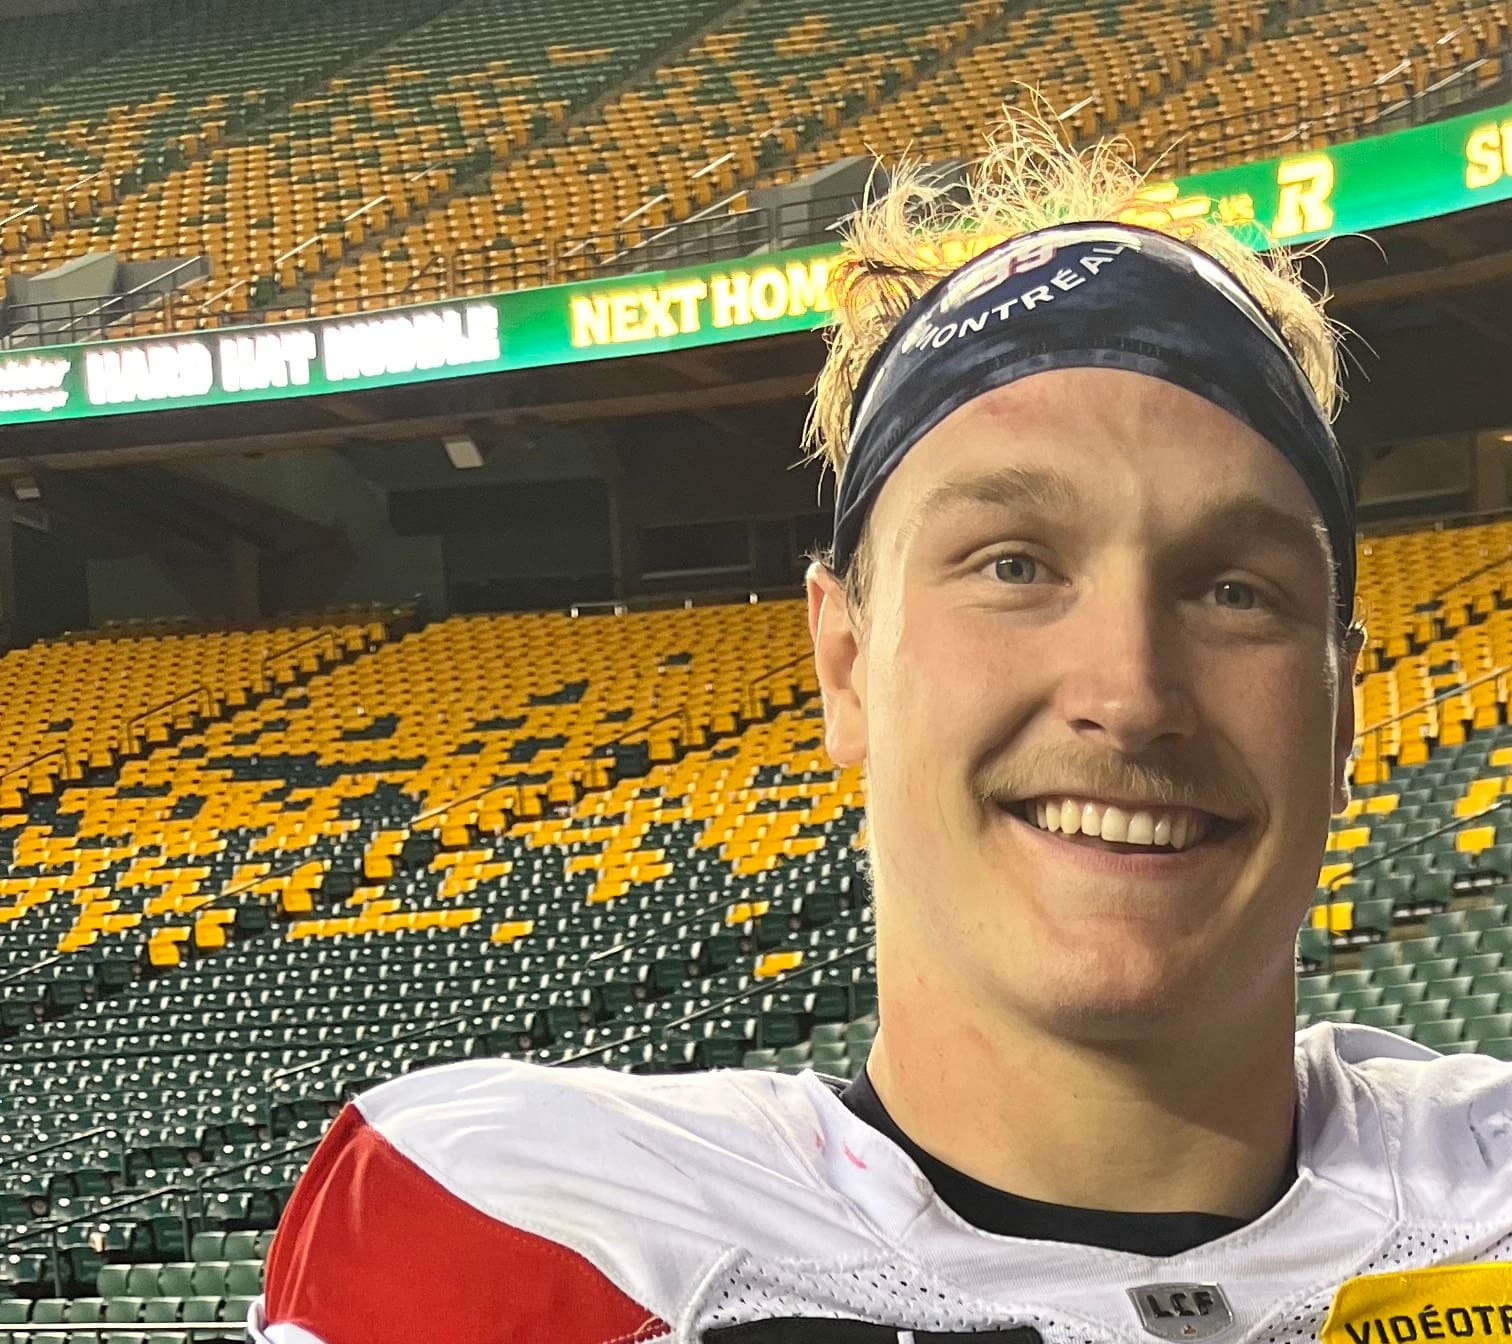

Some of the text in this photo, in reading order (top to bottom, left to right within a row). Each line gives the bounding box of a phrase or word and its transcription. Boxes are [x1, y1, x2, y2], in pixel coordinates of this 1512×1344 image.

[1272, 153, 1334, 239] R
[570, 257, 842, 347] NEXT HOM
[86, 339, 213, 405] HARD
[219, 327, 317, 392] HAT
